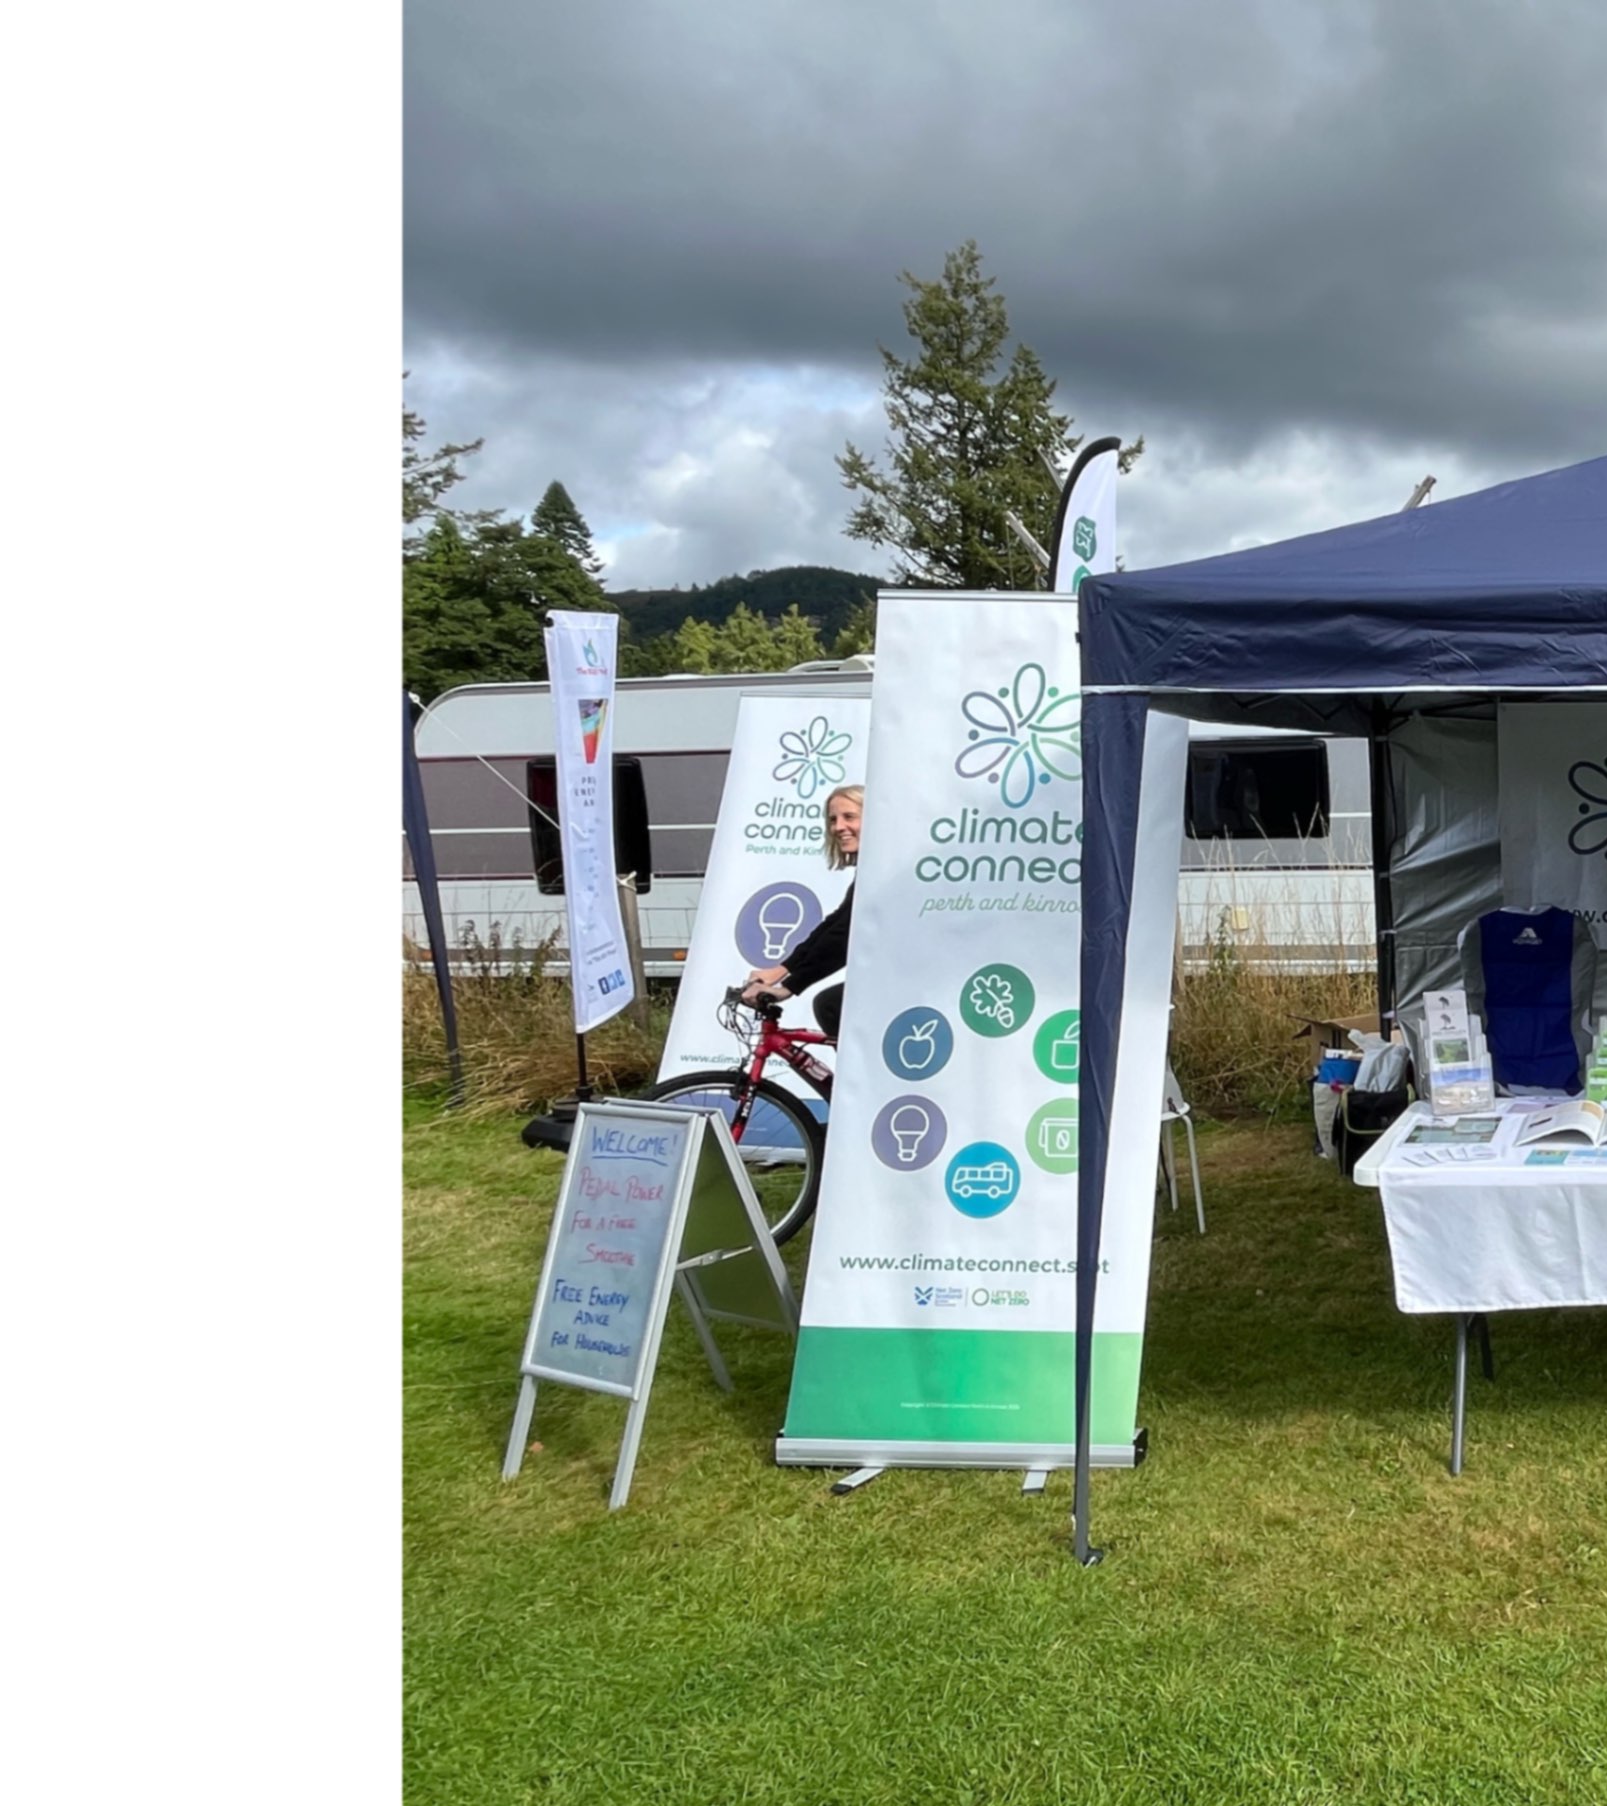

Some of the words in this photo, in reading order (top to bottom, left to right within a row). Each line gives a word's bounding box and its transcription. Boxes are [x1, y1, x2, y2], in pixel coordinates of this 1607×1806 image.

[754, 797, 821, 819] clima
[744, 823, 823, 841] conne
[745, 843, 776, 855] Perth
[779, 846, 800, 856] and
[803, 847, 823, 856] Kin
[915, 856, 1082, 885] connec
[918, 892, 975, 918] perth
[979, 892, 1019, 911] and
[1022, 893, 1081, 913] kinro
[591, 1125, 678, 1157] WELCOME!
[579, 1166, 620, 1201] PEDAL
[625, 1175, 664, 1203] POWER
[571, 1210, 591, 1234] FOR
[596, 1216, 606, 1231] A
[578, 1243, 636, 1267] SMOOTHIE
[839, 1253, 1110, 1274] www.climateconnect.st
[553, 1278, 583, 1304] FREE
[588, 1286, 631, 1313] ENERGY
[991, 1297, 1007, 1306] NET
[1009, 1298, 1030, 1306] ZERO
[573, 1309, 610, 1327] ADVICE
[550, 1330, 569, 1348] FOR
[574, 1333, 632, 1358] HOUSEHOLDS
